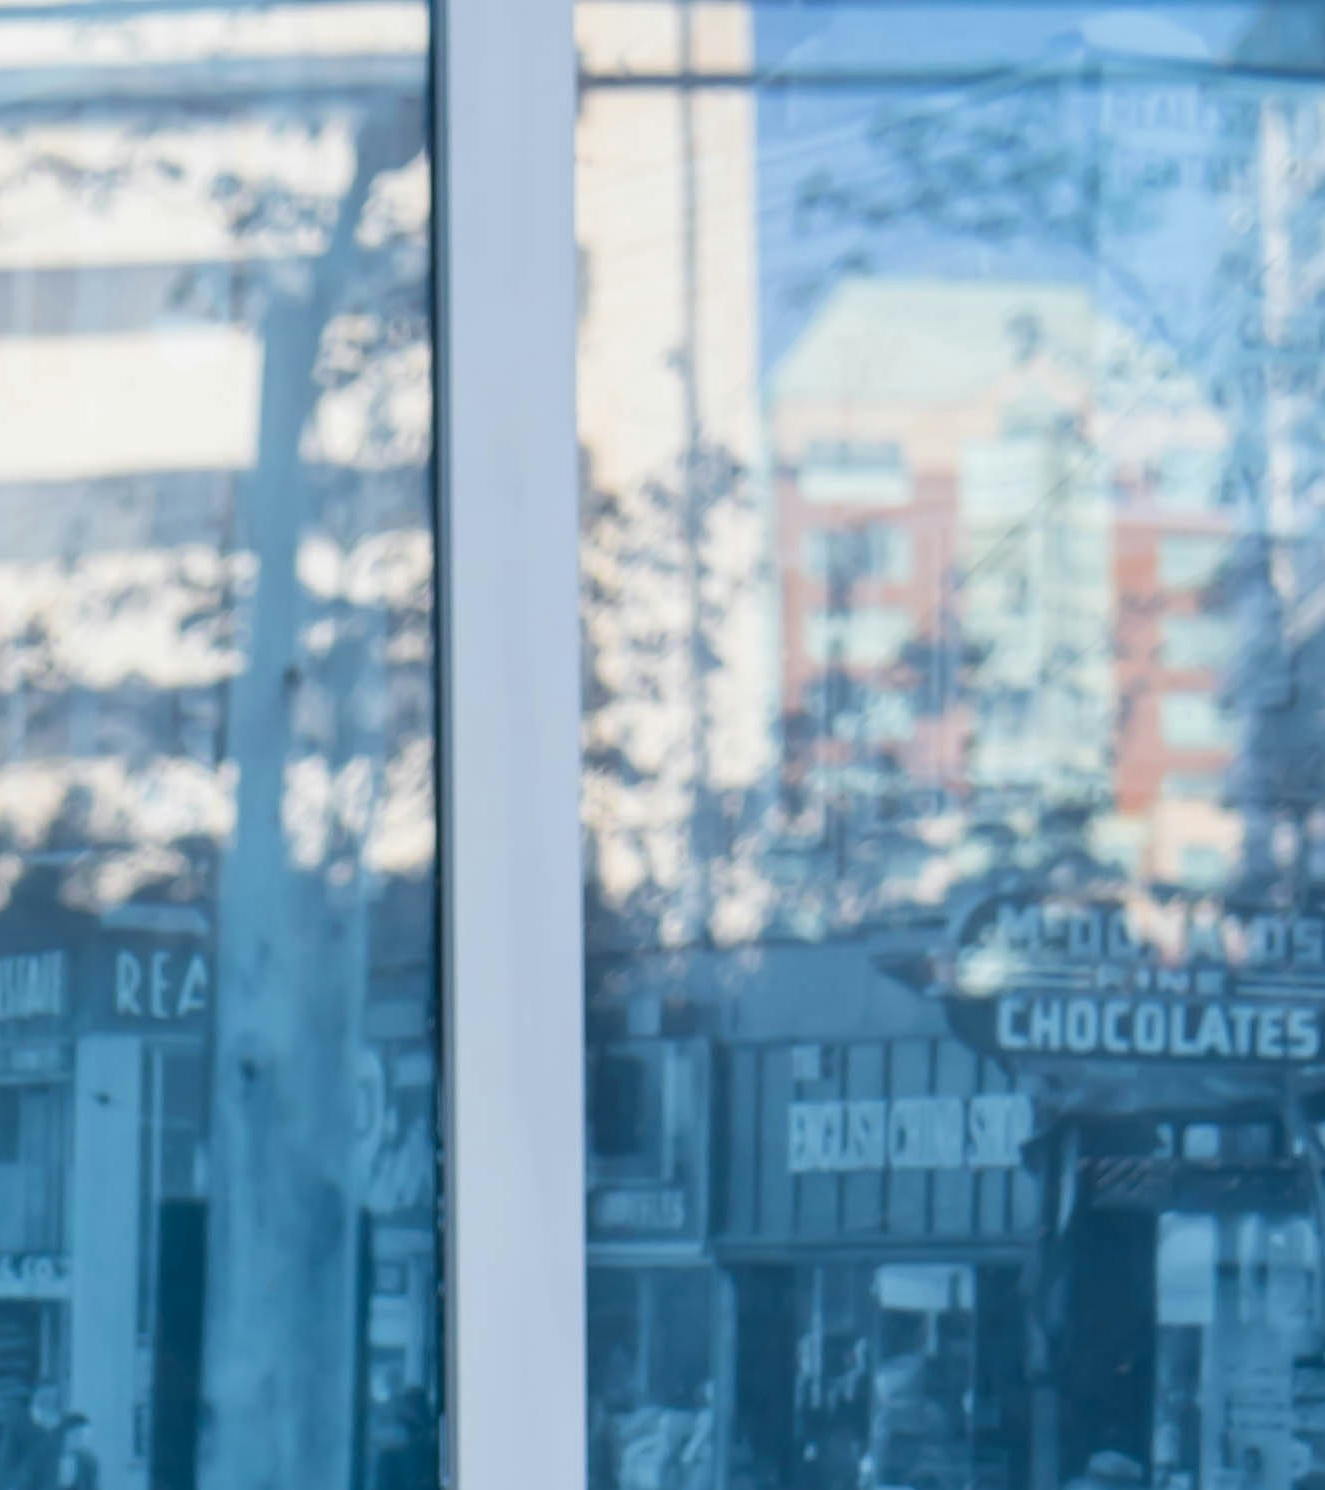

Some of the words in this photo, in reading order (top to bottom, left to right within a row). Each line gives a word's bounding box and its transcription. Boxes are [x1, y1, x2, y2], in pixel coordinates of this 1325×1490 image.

[998, 998, 1319, 1060] CHOCOLATES
[788, 1102, 887, 1172] ENGLISH
[889, 1098, 964, 1169] CHINA
